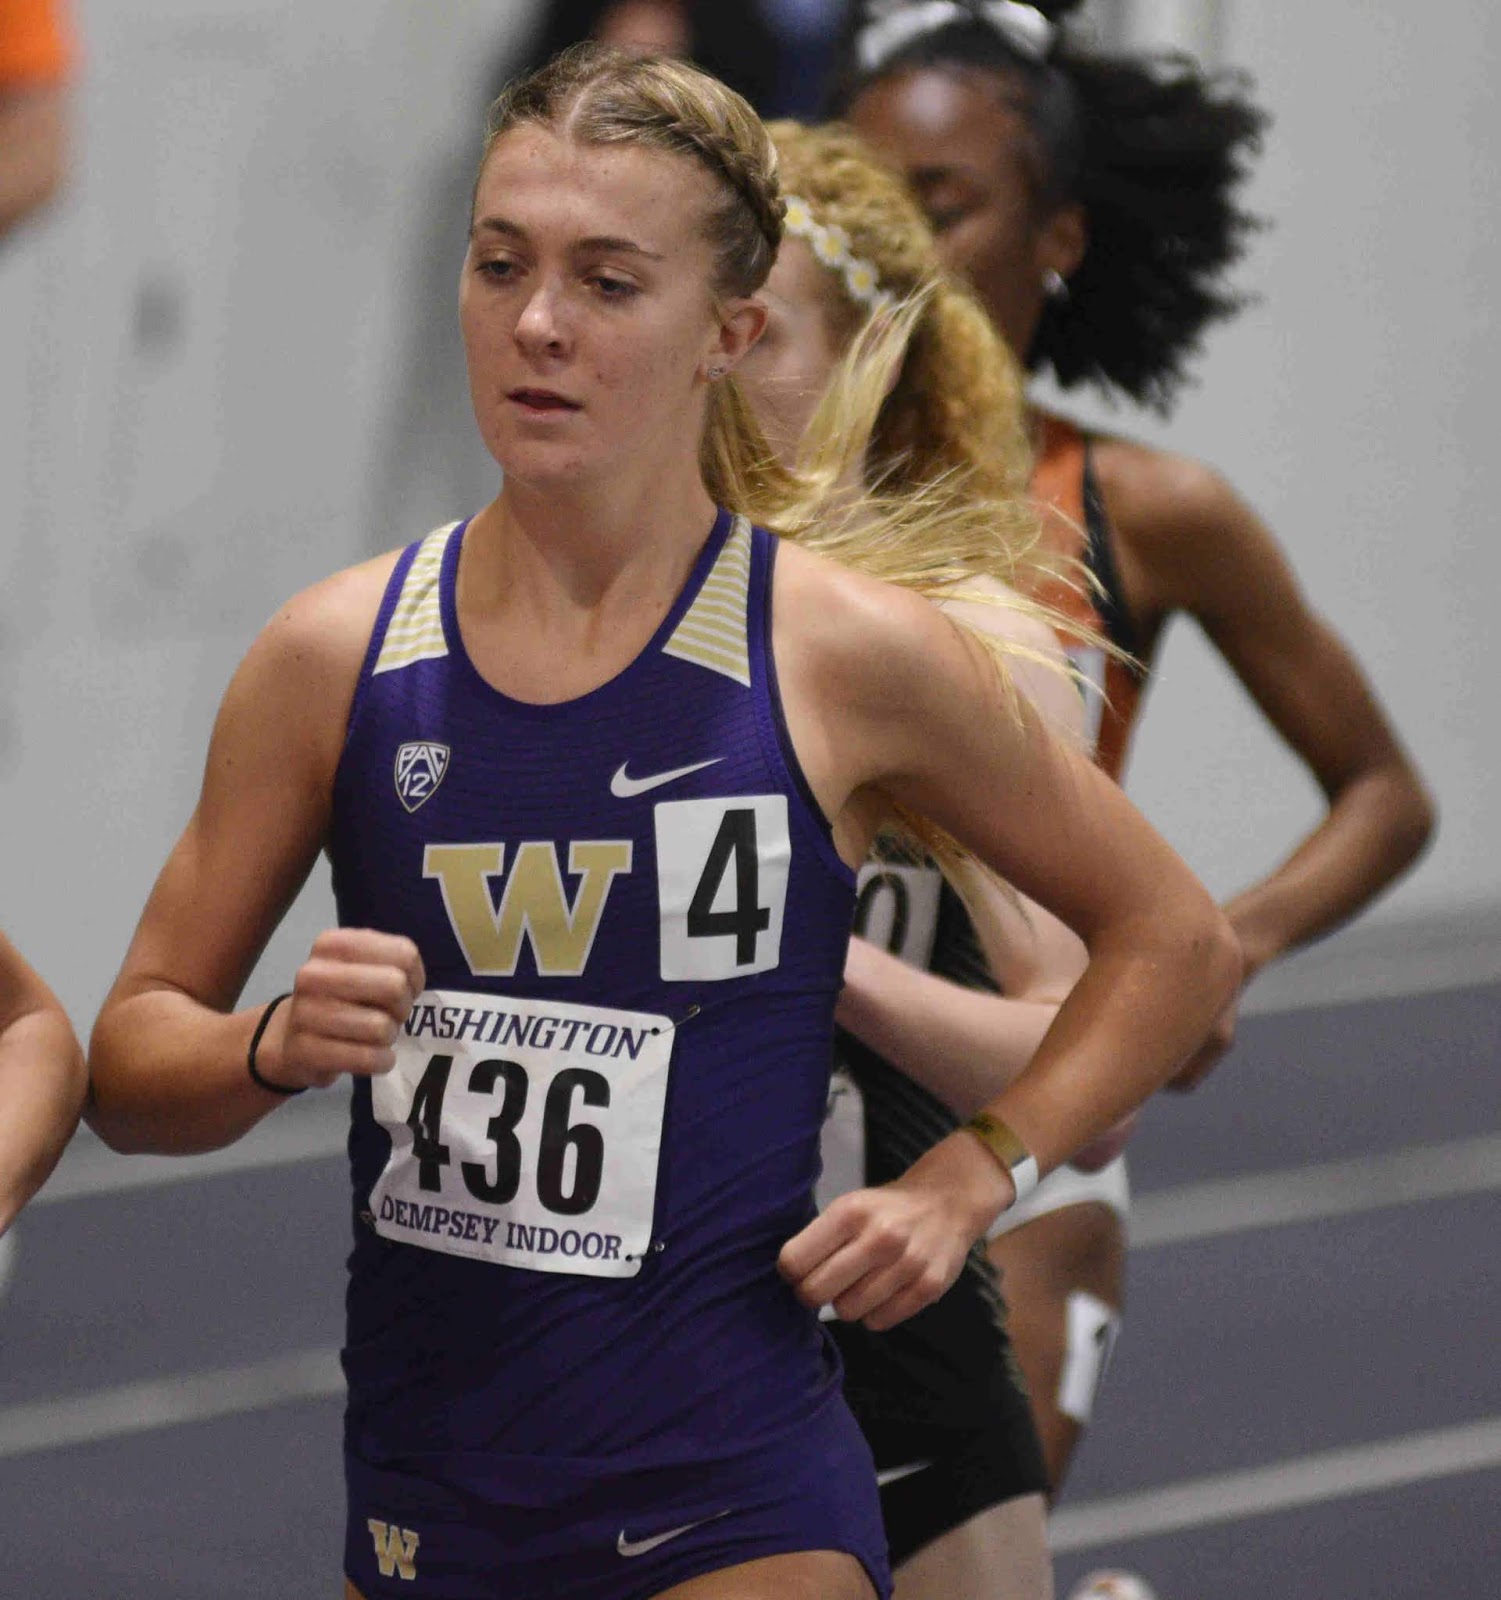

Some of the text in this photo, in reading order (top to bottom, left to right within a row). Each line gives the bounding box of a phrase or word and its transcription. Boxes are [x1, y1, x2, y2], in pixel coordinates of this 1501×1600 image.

[398, 745, 447, 785] PAC
[402, 772, 431, 797] 12
[422, 839, 634, 977] W
[687, 808, 770, 967] 4
[406, 1054, 611, 1216] 436
[380, 1195, 500, 1244] DEMPSEY
[505, 1221, 622, 1261] INDOOR
[367, 1518, 420, 1581] W
